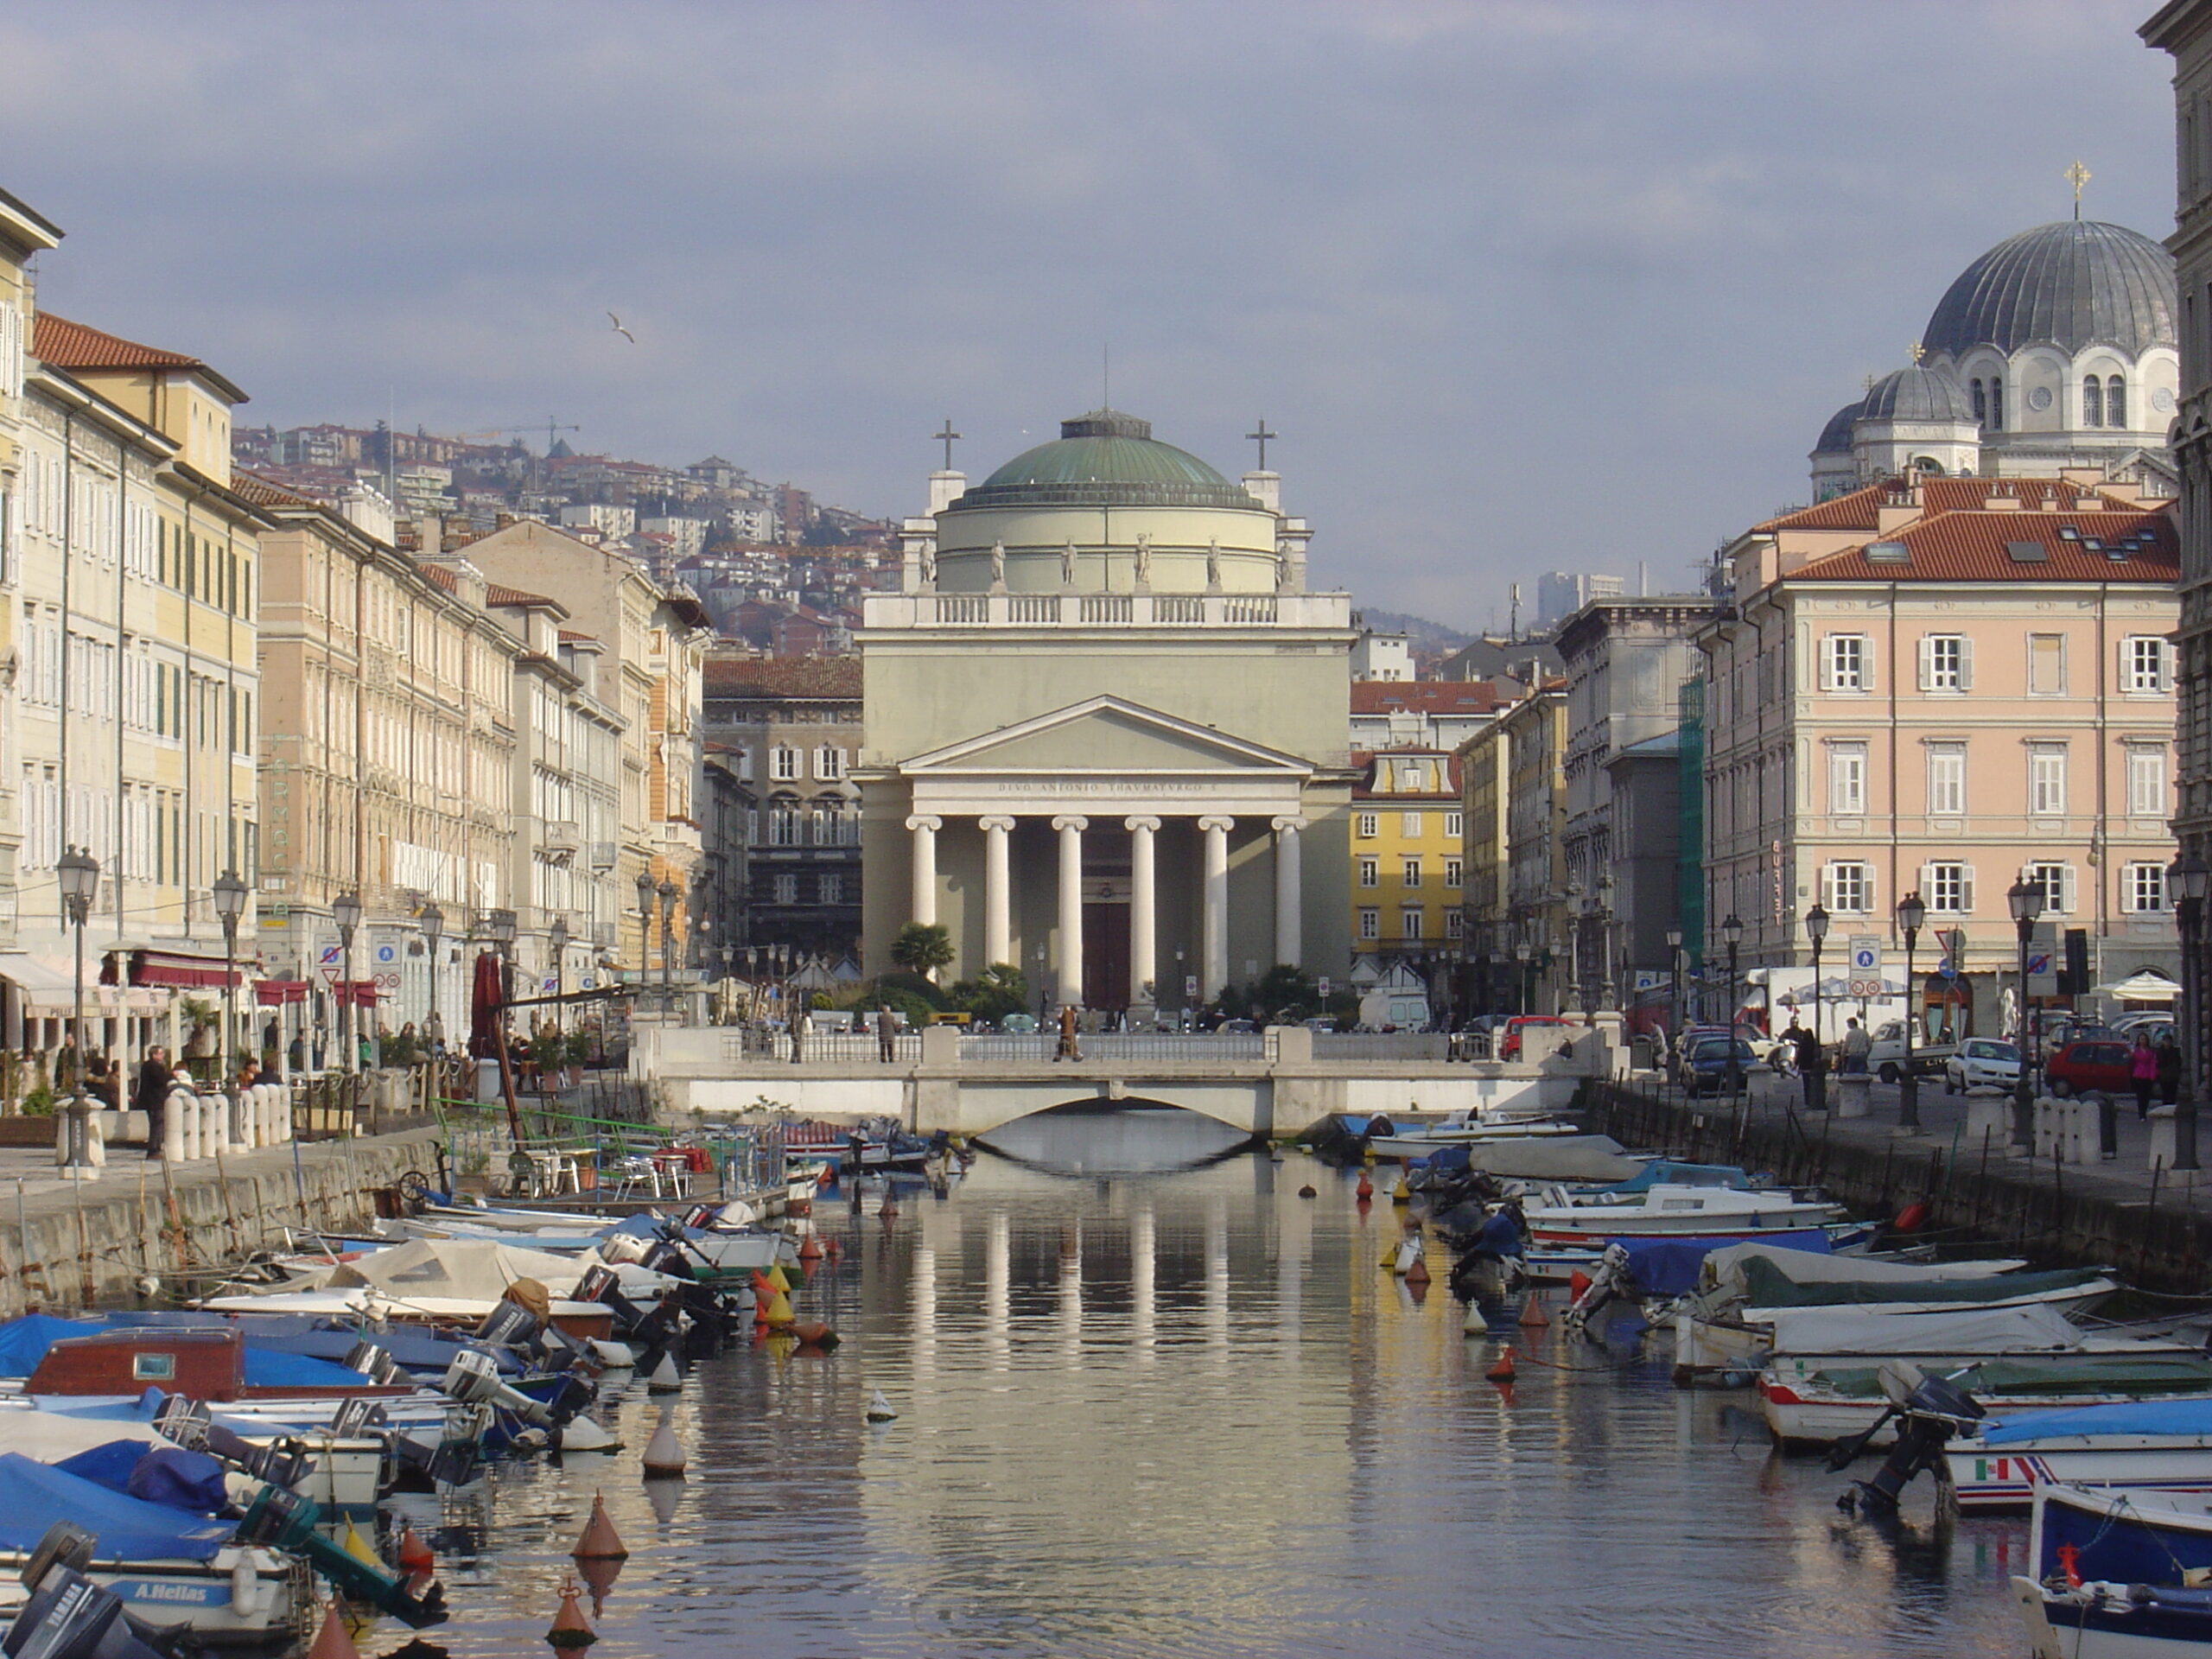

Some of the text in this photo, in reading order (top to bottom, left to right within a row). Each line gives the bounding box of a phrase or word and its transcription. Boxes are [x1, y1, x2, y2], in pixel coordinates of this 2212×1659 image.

[998, 784, 1032, 792] DIVO
[1040, 784, 1099, 792] ANTONIO
[272, 733, 289, 916] FARMACIA
[50, 1007, 73, 1017] PELLE
[499, 1311, 518, 1333] YAMAHA
[133, 1583, 207, 1601] A.Hellas
[47, 1583, 84, 1627] YAMAHA
